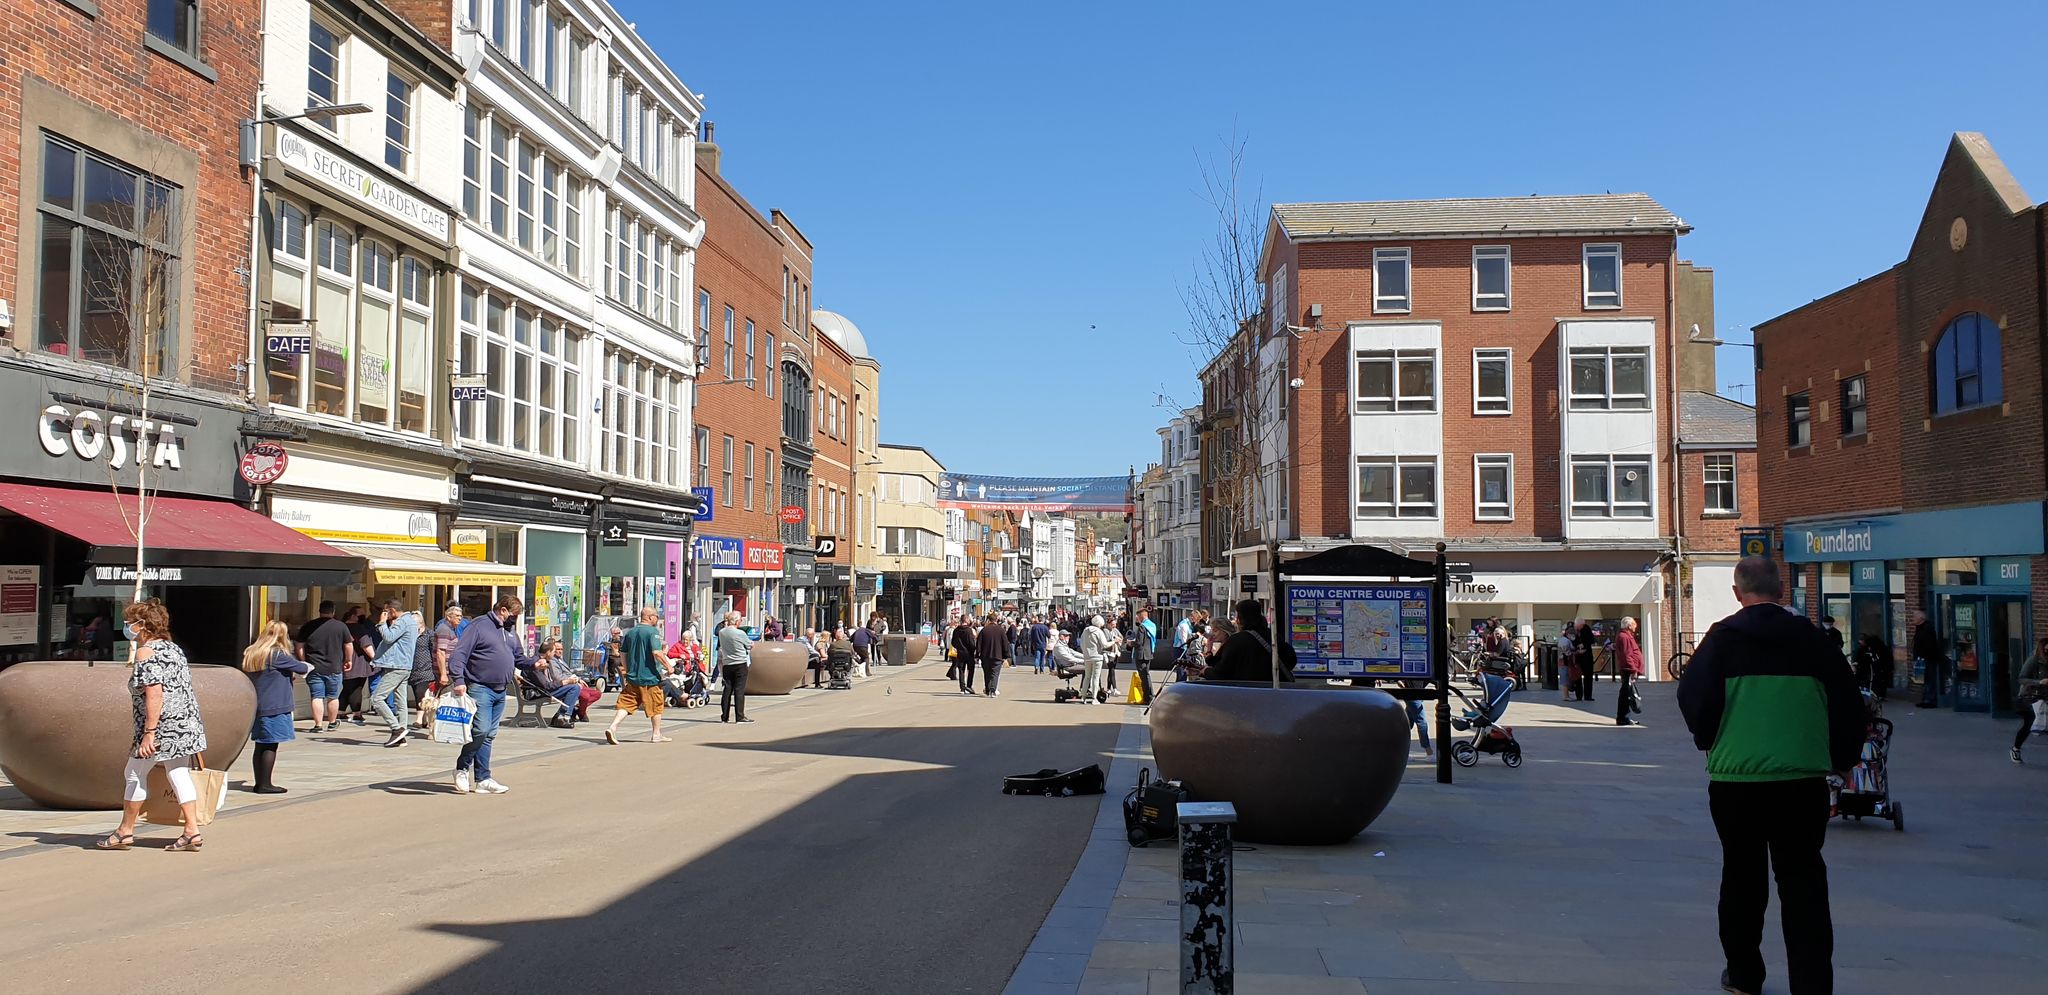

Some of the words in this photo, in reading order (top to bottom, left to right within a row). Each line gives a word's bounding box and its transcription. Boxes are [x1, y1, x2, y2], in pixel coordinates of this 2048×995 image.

[313, 151, 364, 191] SECRET
[371, 182, 419, 219] GARDEN
[421, 207, 445, 233] CAFE
[267, 337, 310, 352] CAFE
[452, 388, 486, 400] CAFE
[39, 404, 181, 469] COSTA
[252, 446, 281, 457] COSTA
[244, 465, 279, 480] COFFEE
[272, 509, 290, 523] uality
[817, 540, 834, 553] JD
[1806, 526, 1871, 554] Poundland
[701, 539, 740, 566] WHSmith
[748, 547, 761, 563] POST
[762, 548, 779, 564] OFFICE
[160, 568, 182, 581] COFFEE
[1862, 567, 1875, 579] EXIT
[2001, 564, 2019, 578] EXIT
[1291, 589, 1324, 598] TOWN
[1328, 590, 1373, 598] CENTRE
[1376, 590, 1411, 599] GUIDE
